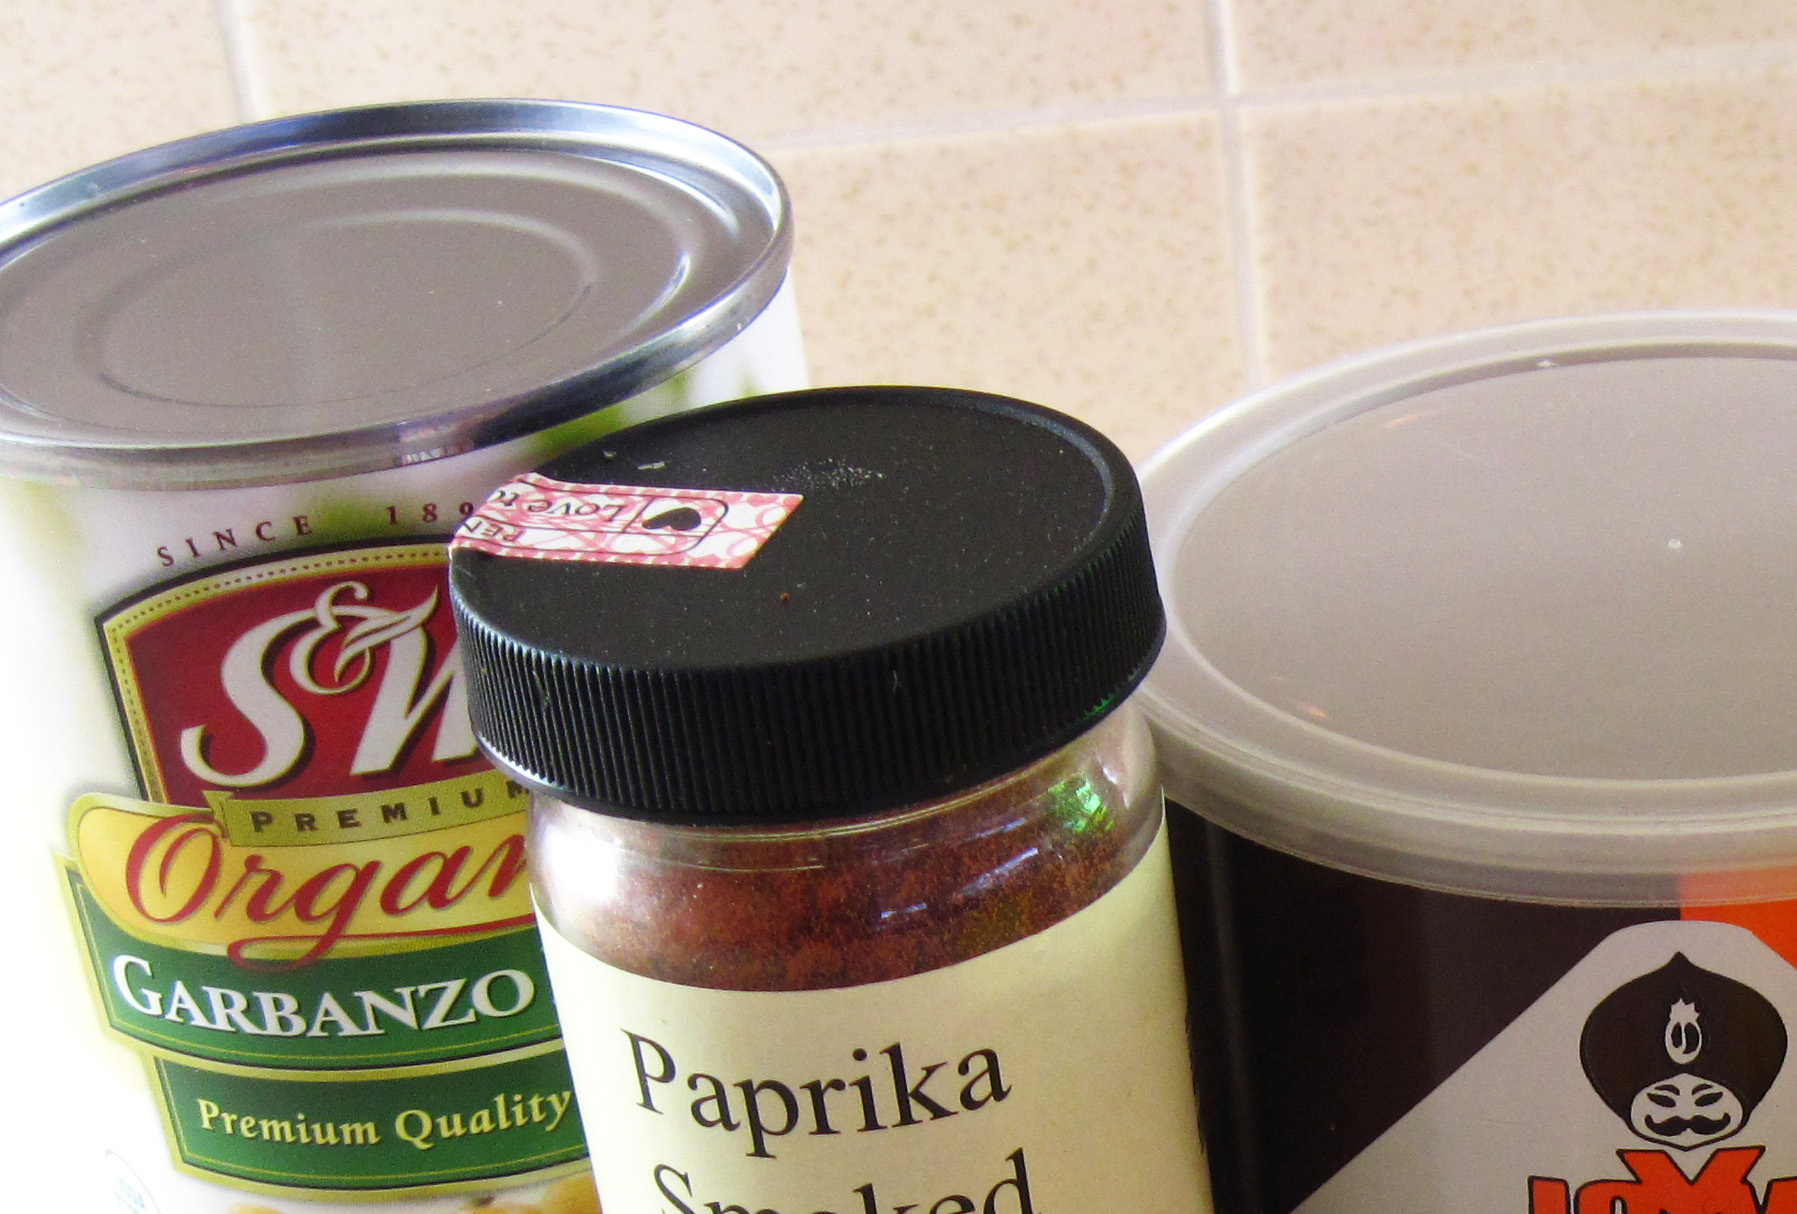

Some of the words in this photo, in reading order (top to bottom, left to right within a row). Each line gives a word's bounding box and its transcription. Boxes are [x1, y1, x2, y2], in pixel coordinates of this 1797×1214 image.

[157, 515, 312, 567] SINCE
[527, 499, 625, 523] Love
[112, 953, 536, 1037] GARBANZO
[197, 1097, 381, 1146] Premium
[395, 1090, 572, 1150] Quality
[620, 1028, 1013, 1158] Paprika
